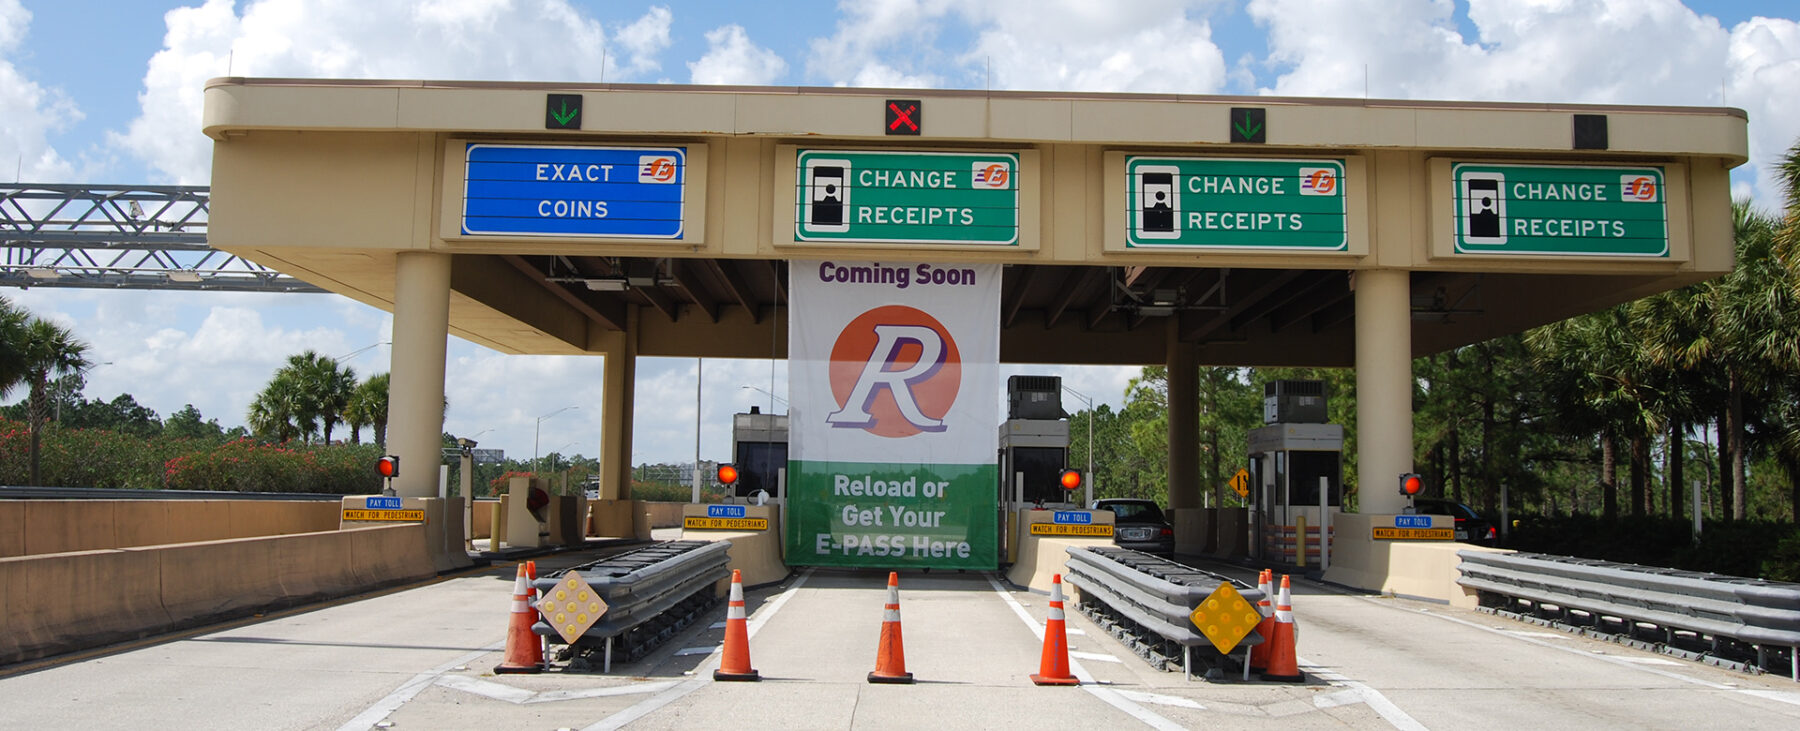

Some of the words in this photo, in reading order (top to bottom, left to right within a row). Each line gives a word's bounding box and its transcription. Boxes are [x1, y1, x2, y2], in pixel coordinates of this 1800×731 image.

[536, 163, 614, 182] EXACT
[859, 169, 957, 189] CHANGE
[1188, 176, 1285, 195] CHANGE
[1513, 183, 1607, 201] CHANGE
[538, 199, 609, 218] COINS
[858, 206, 974, 226] RECEIPTS
[1188, 212, 1303, 231] RECEIPTS
[1514, 219, 1625, 237] RECEIPTS
[819, 261, 911, 289] Coming
[915, 263, 976, 286] Soon
[825, 324, 948, 432] R
[834, 474, 916, 497] Reload
[922, 480, 949, 498] or
[369, 499, 382, 507] PAY
[385, 499, 399, 507] TOLL
[711, 507, 724, 516] PAY
[727, 507, 741, 516] TOLL
[345, 511, 365, 519] WATCH
[368, 511, 379, 519] FOR
[384, 511, 422, 519] PEDESTRIANS
[687, 519, 707, 527] WATCH
[711, 519, 722, 527] FOR
[727, 520, 765, 528] PEDESTRIANS
[841, 503, 883, 527] Get
[888, 505, 946, 528] Your
[1058, 513, 1070, 522] PAY
[1073, 513, 1087, 522] TOLL
[1398, 517, 1411, 526] PAY
[1414, 517, 1428, 526] TOLL
[1033, 525, 1052, 533] WATCH
[1072, 526, 1111, 535] PEDESTRIANS
[1414, 530, 1452, 538] PEDESTRIANS
[815, 533, 906, 557] E-PASS
[912, 535, 971, 559] Here
